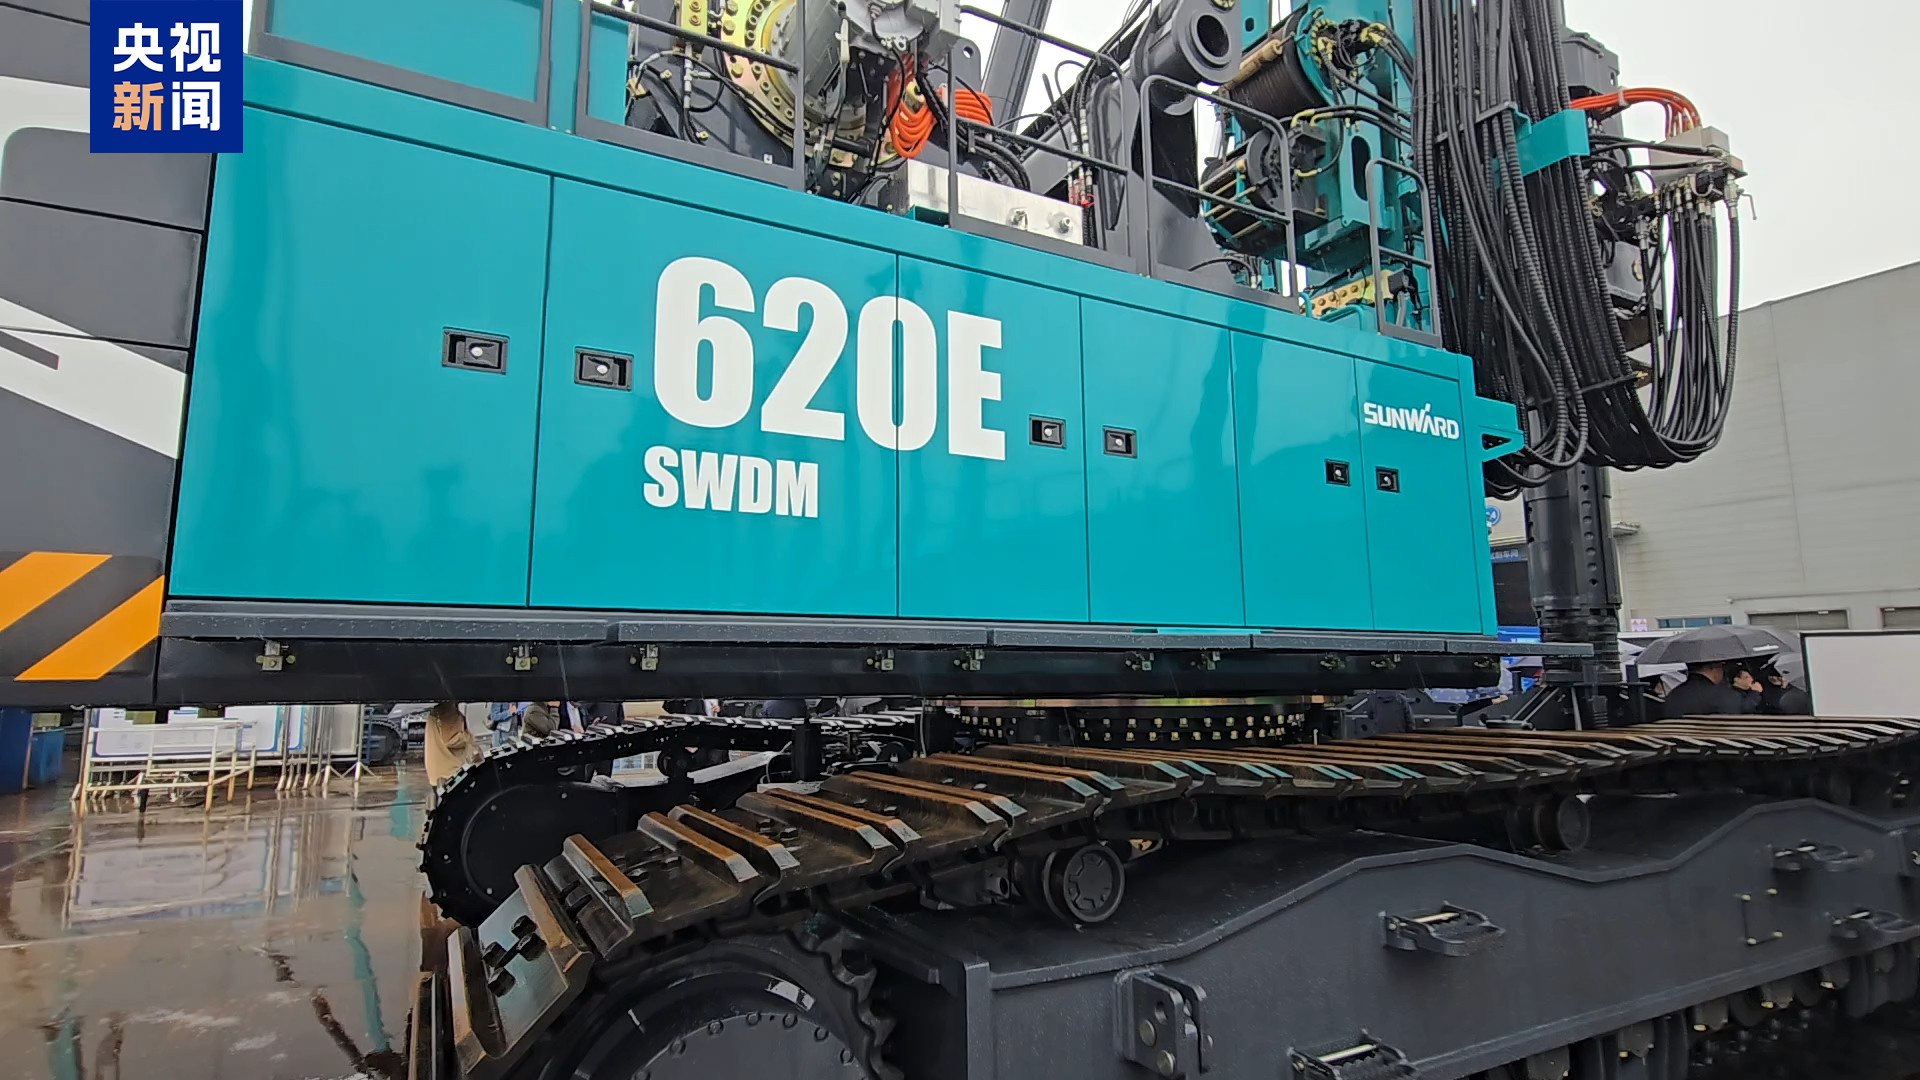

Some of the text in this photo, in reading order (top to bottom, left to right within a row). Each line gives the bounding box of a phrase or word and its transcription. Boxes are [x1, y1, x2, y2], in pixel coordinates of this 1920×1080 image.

[654, 256, 1006, 460] 620E
[1363, 402, 1460, 440] SUNWARD
[643, 446, 818, 518] SWDM
